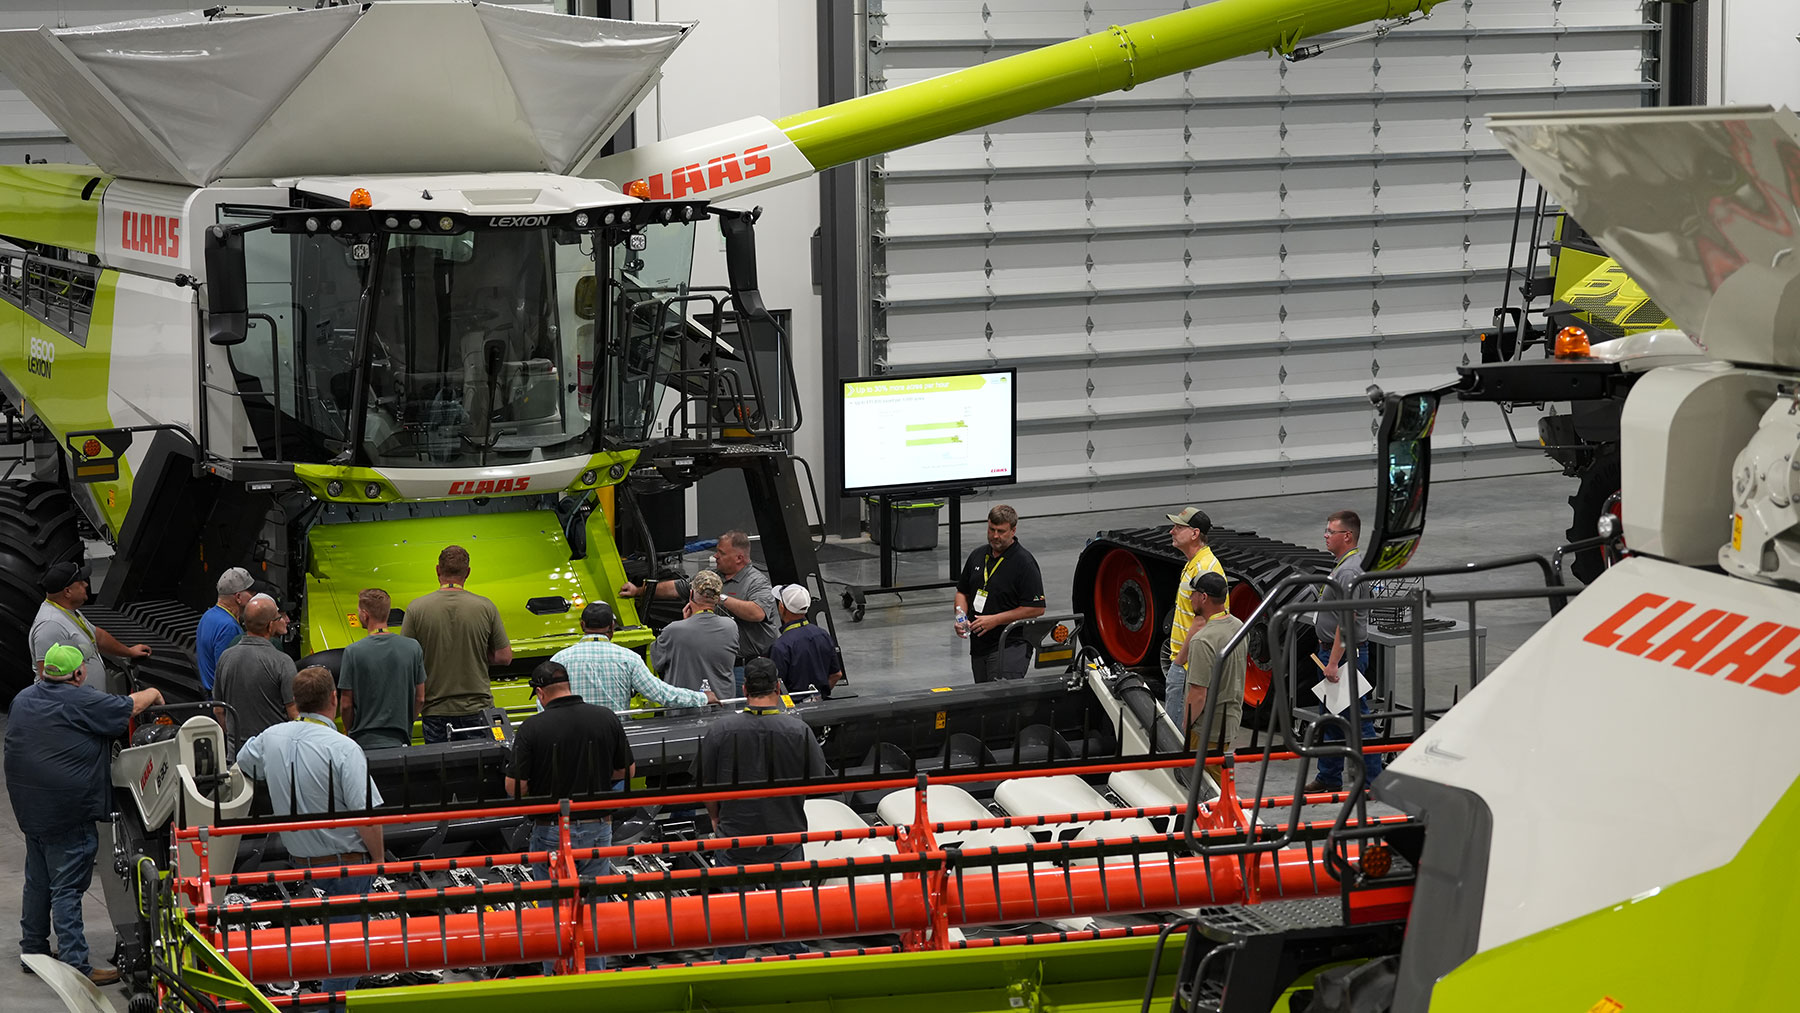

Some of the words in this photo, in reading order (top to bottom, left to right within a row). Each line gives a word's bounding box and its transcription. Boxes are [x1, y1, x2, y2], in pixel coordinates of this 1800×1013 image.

[122, 210, 179, 258] CLAAS
[489, 216, 551, 227] LEXION
[30, 336, 55, 363] 8600
[27, 355, 52, 379] LEXION
[855, 386, 865, 394] Up
[448, 476, 531, 495] CLAAS
[1582, 592, 1800, 695] CLAAS
[140, 758, 154, 791] CLAAS
